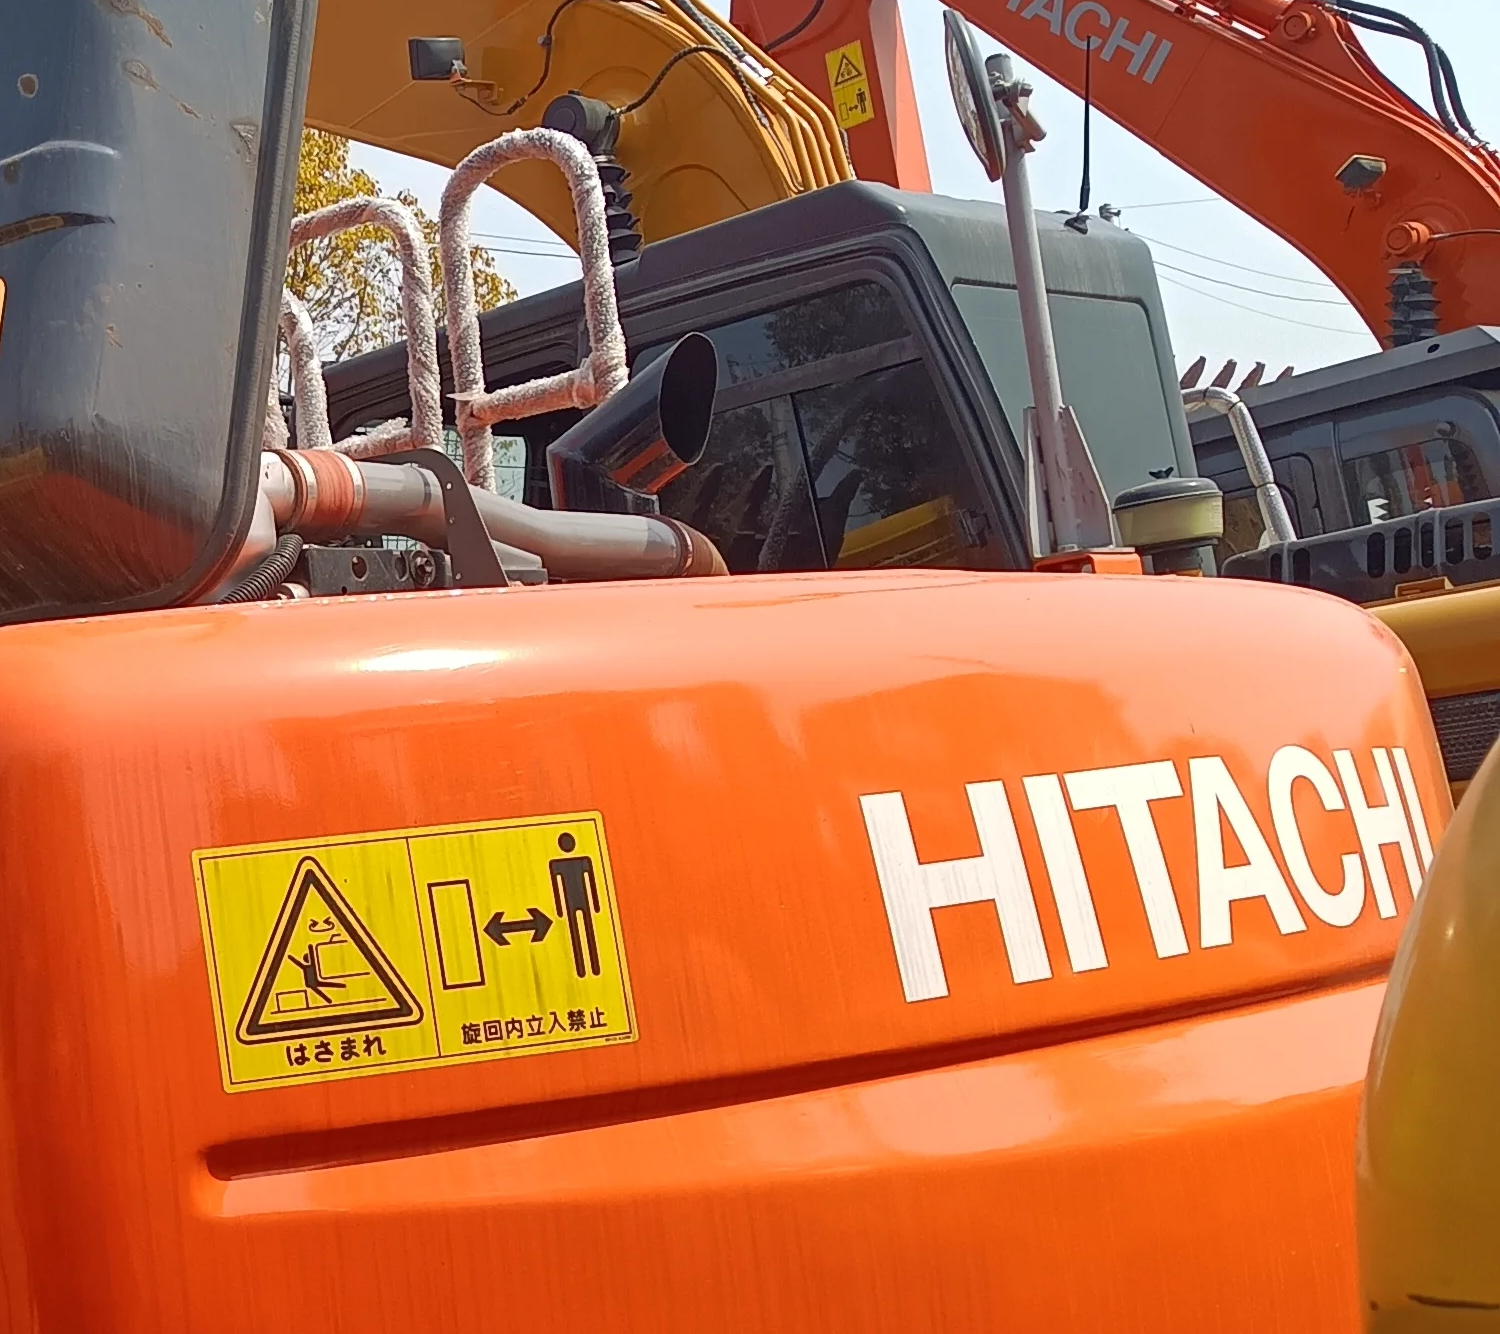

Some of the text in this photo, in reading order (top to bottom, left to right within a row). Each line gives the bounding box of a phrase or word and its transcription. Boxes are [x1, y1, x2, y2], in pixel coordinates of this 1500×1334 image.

[858, 744, 1436, 1003] HITACHI
[461, 1007, 608, 1045] 旋回内立入禁止
[286, 1034, 387, 1067] はさまれ
